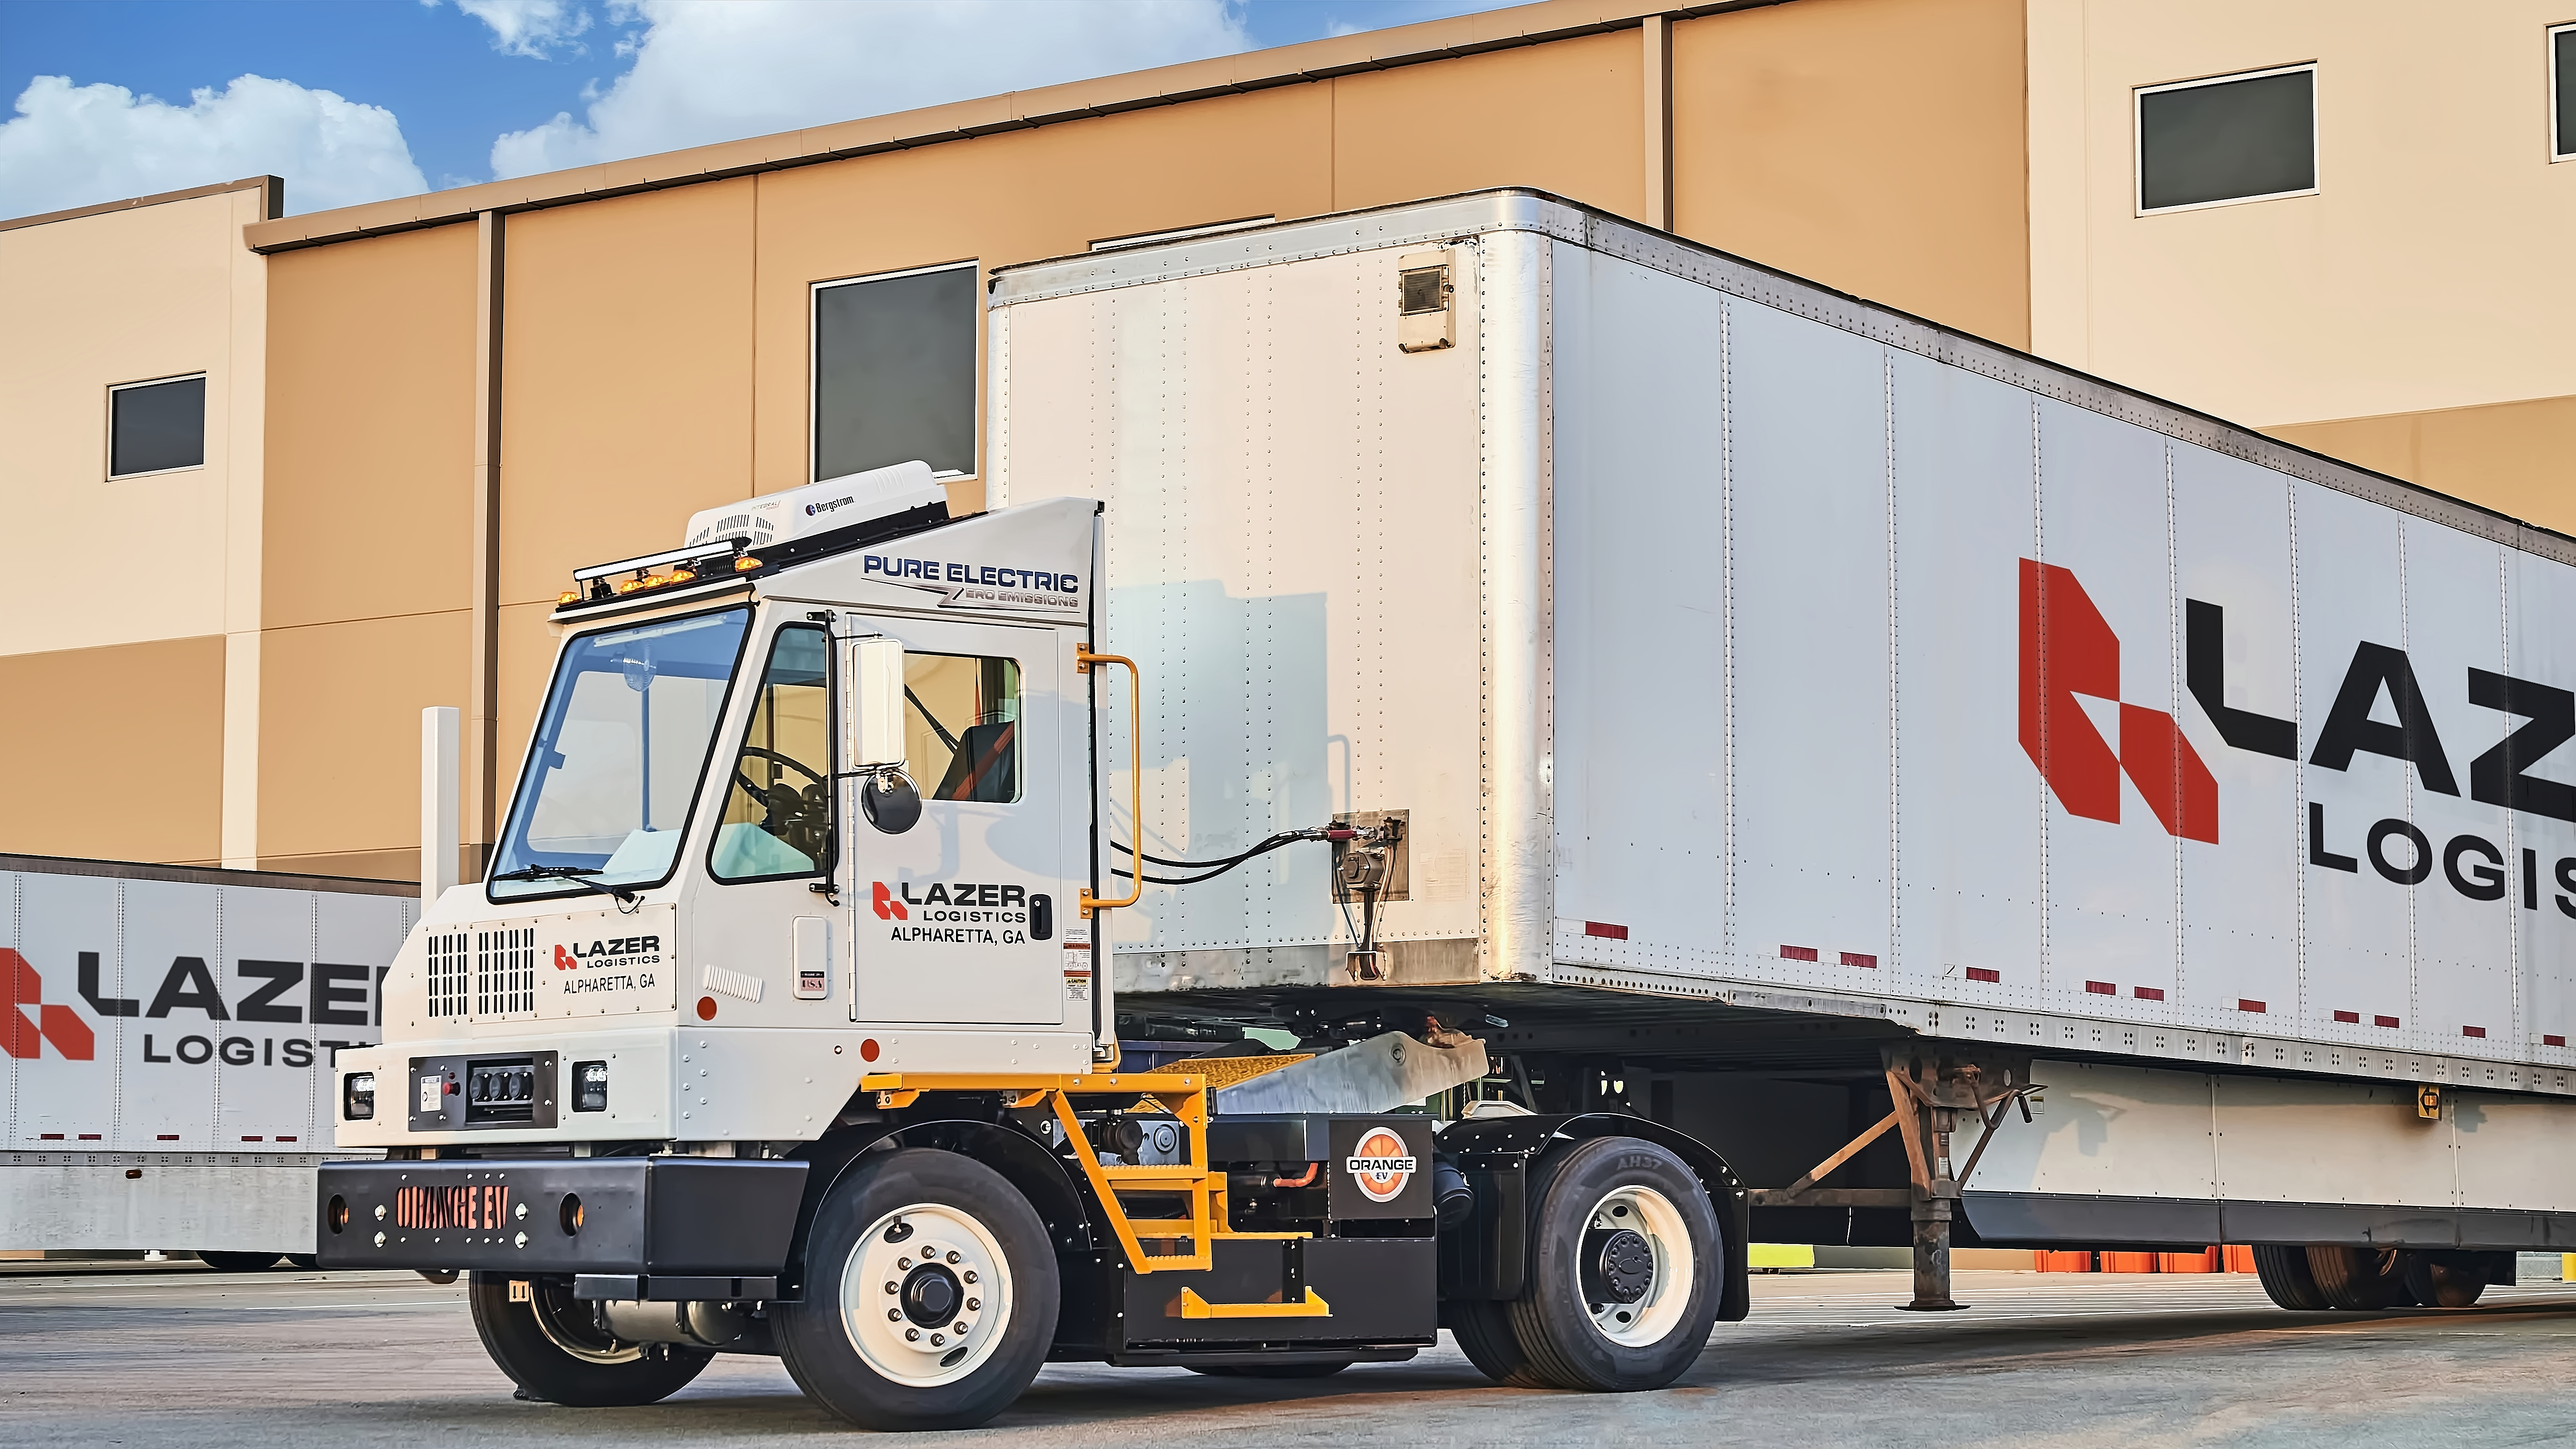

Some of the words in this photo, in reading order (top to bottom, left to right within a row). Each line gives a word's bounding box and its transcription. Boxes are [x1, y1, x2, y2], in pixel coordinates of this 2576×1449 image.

[816, 496, 854, 513] Bergstrom
[864, 555, 939, 579] PURE
[947, 563, 1078, 593] ELECTRIC
[998, 591, 1078, 608] EMISSIONS
[902, 882, 1025, 907] LAZER
[923, 910, 1026, 924] LOGISTICS
[891, 927, 997, 946] ALPHARETTA,
[1003, 930, 1025, 944] GA
[574, 935, 660, 958] LAZER
[587, 954, 660, 969] LOGISTICS
[564, 975, 636, 994] ALPHARETTA,
[640, 973, 655, 988] GA
[1350, 1160, 1414, 1170] ORANGE
[1375, 1172, 1388, 1180] EV
[396, 1186, 476, 1230] ORANGE
[482, 1186, 509, 1230] EV
